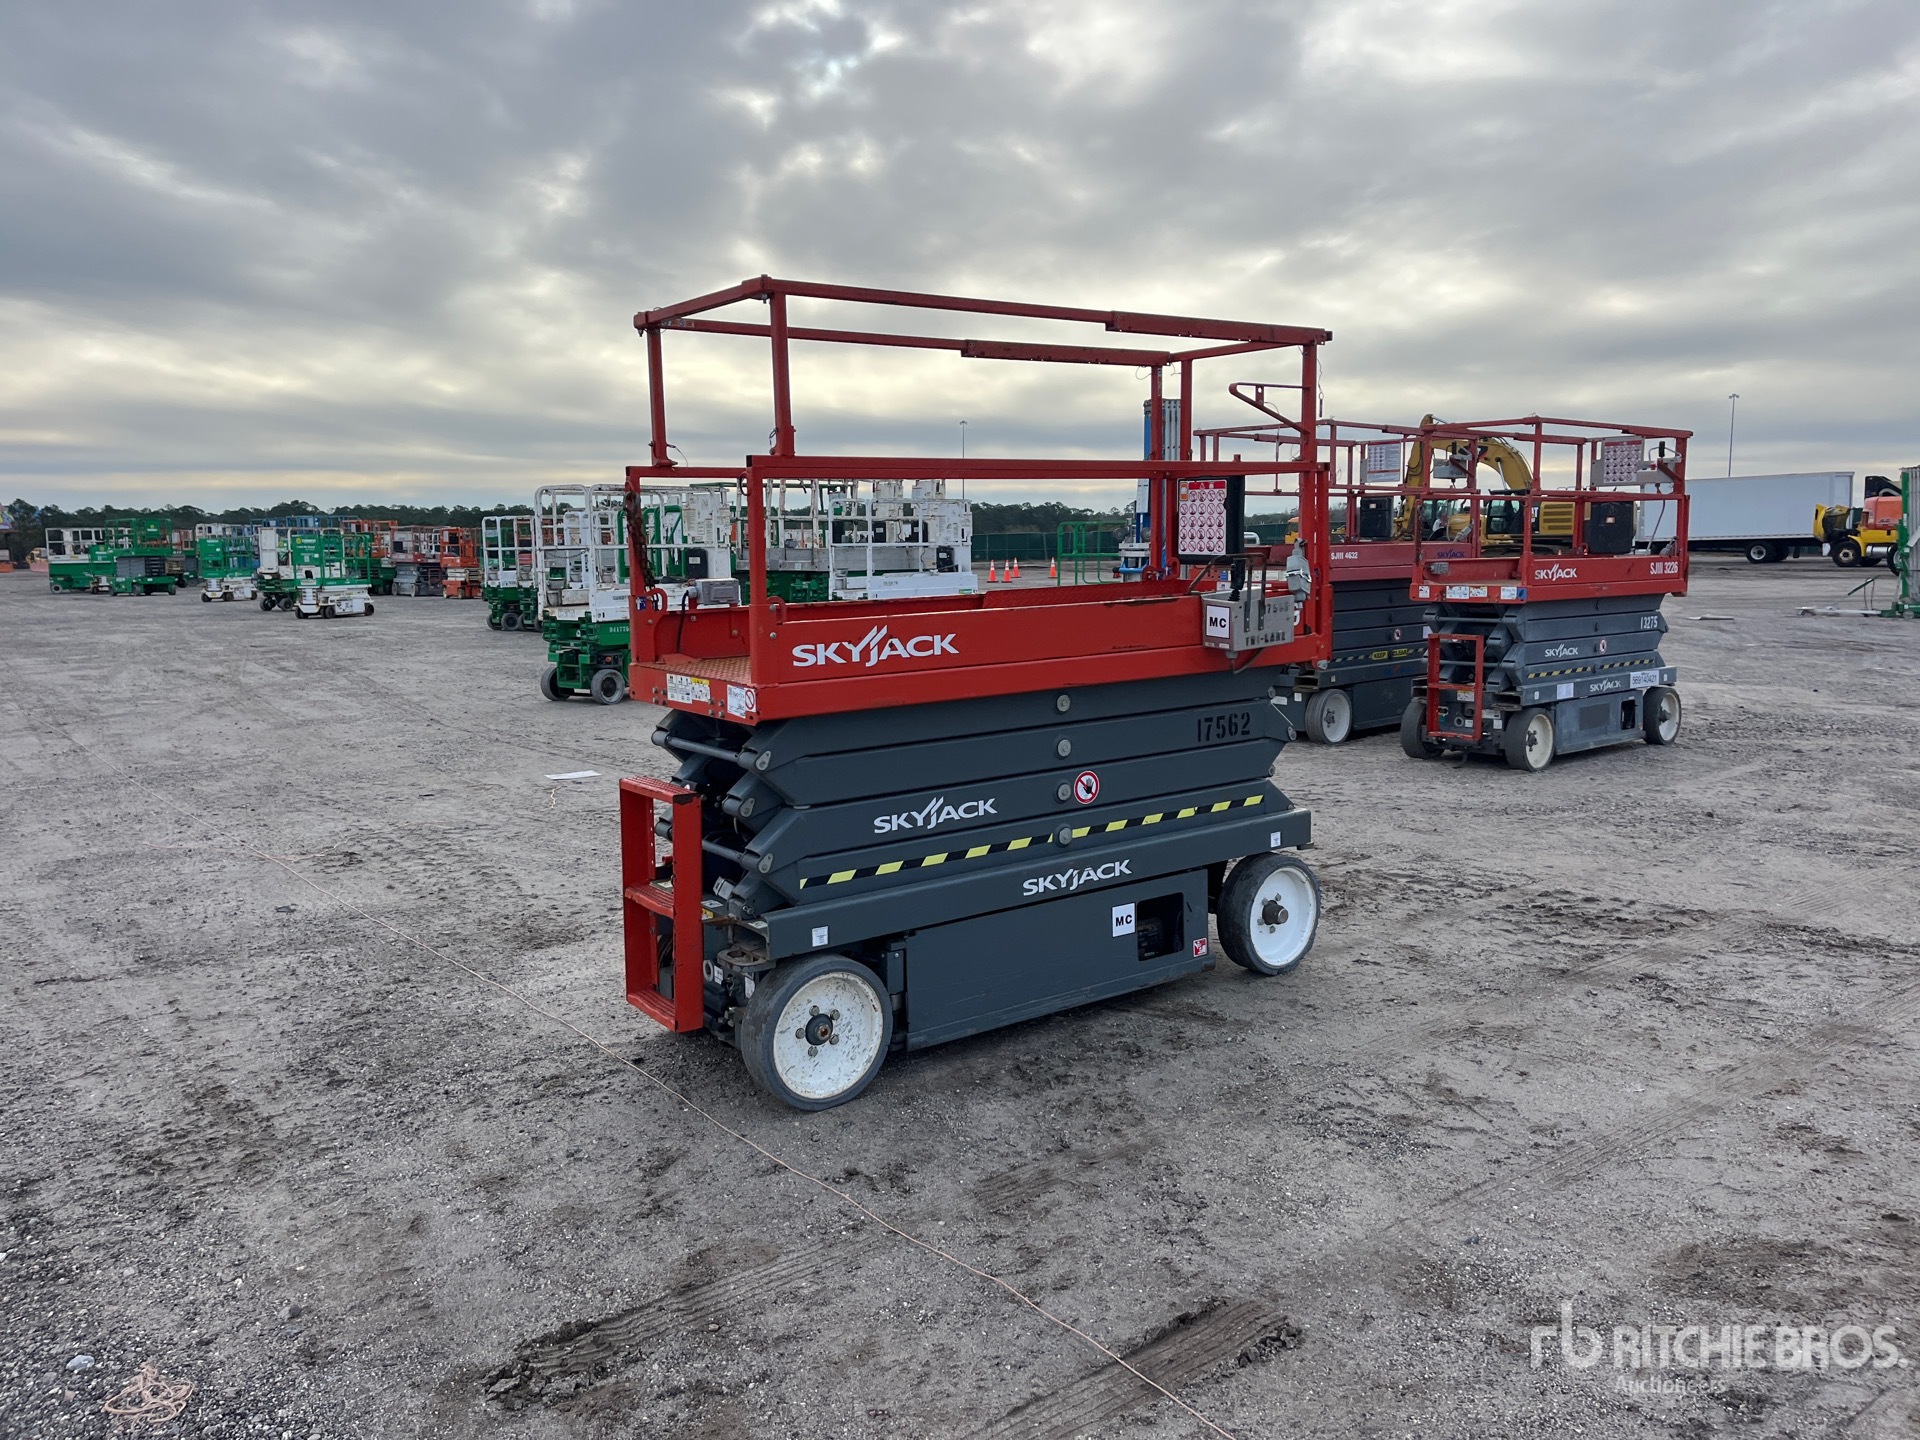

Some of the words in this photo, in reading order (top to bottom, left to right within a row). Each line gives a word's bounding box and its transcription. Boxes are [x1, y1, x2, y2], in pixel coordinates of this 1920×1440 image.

[1437, 548, 1465, 558] SKYJACK
[1535, 563, 1578, 581] SKYJACK
[1664, 561, 1679, 574] 3226
[1209, 616, 1227, 629] MC
[1640, 615, 1658, 630] 13275
[792, 624, 960, 668] SKYJACK
[1544, 643, 1579, 658] SKYJACK
[1589, 678, 1621, 693] SKYJACK
[1197, 711, 1251, 743] 17562
[873, 796, 999, 834] SKYJACK
[1022, 858, 1133, 897] SKYJACK
[1115, 914, 1133, 927] MC
